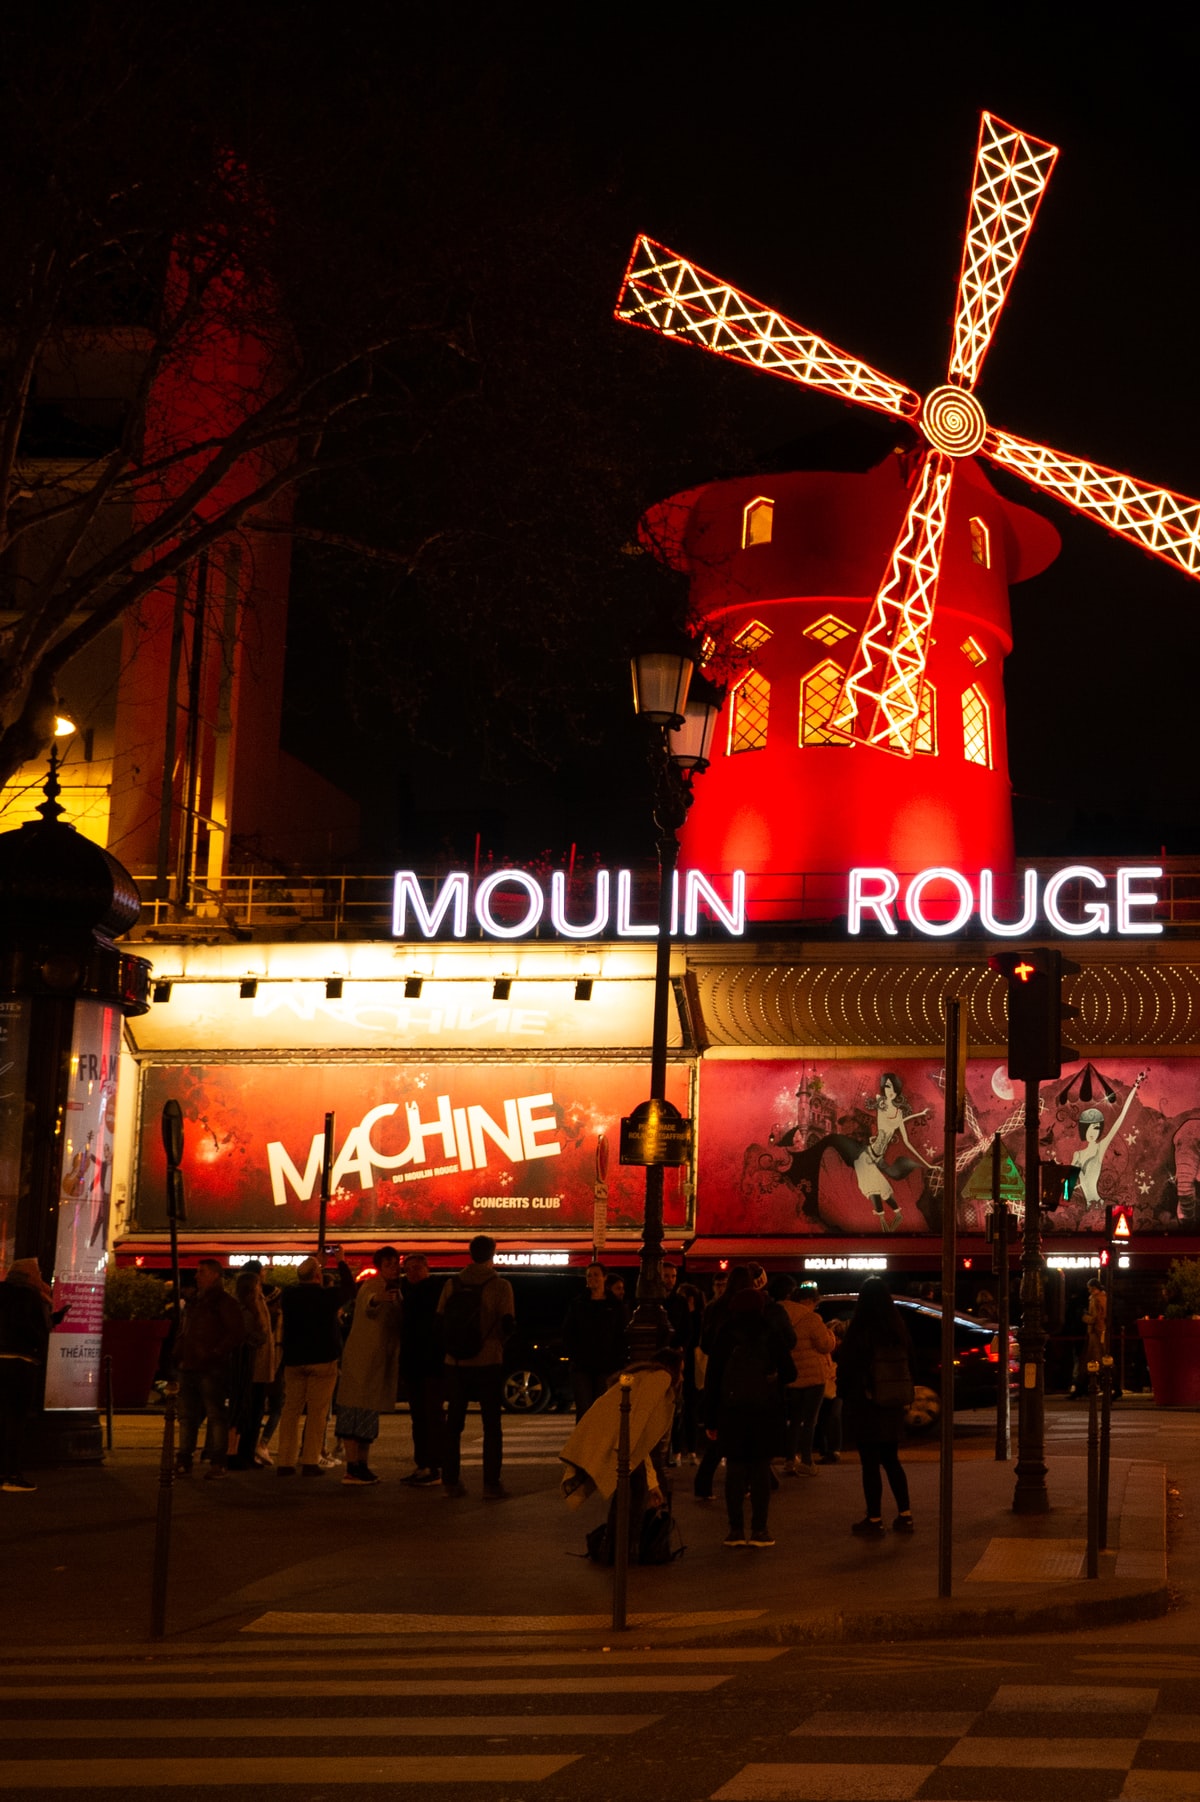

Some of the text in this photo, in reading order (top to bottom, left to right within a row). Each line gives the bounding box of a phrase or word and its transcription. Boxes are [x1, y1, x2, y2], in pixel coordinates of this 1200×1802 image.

[391, 866, 1163, 939] MOULIN ROUGE
[266, 1092, 561, 1206] MACHINE
[392, 1164, 459, 1185] DU MOULIN ROUGE
[473, 1197, 561, 1209] CONCERTS CLUB
